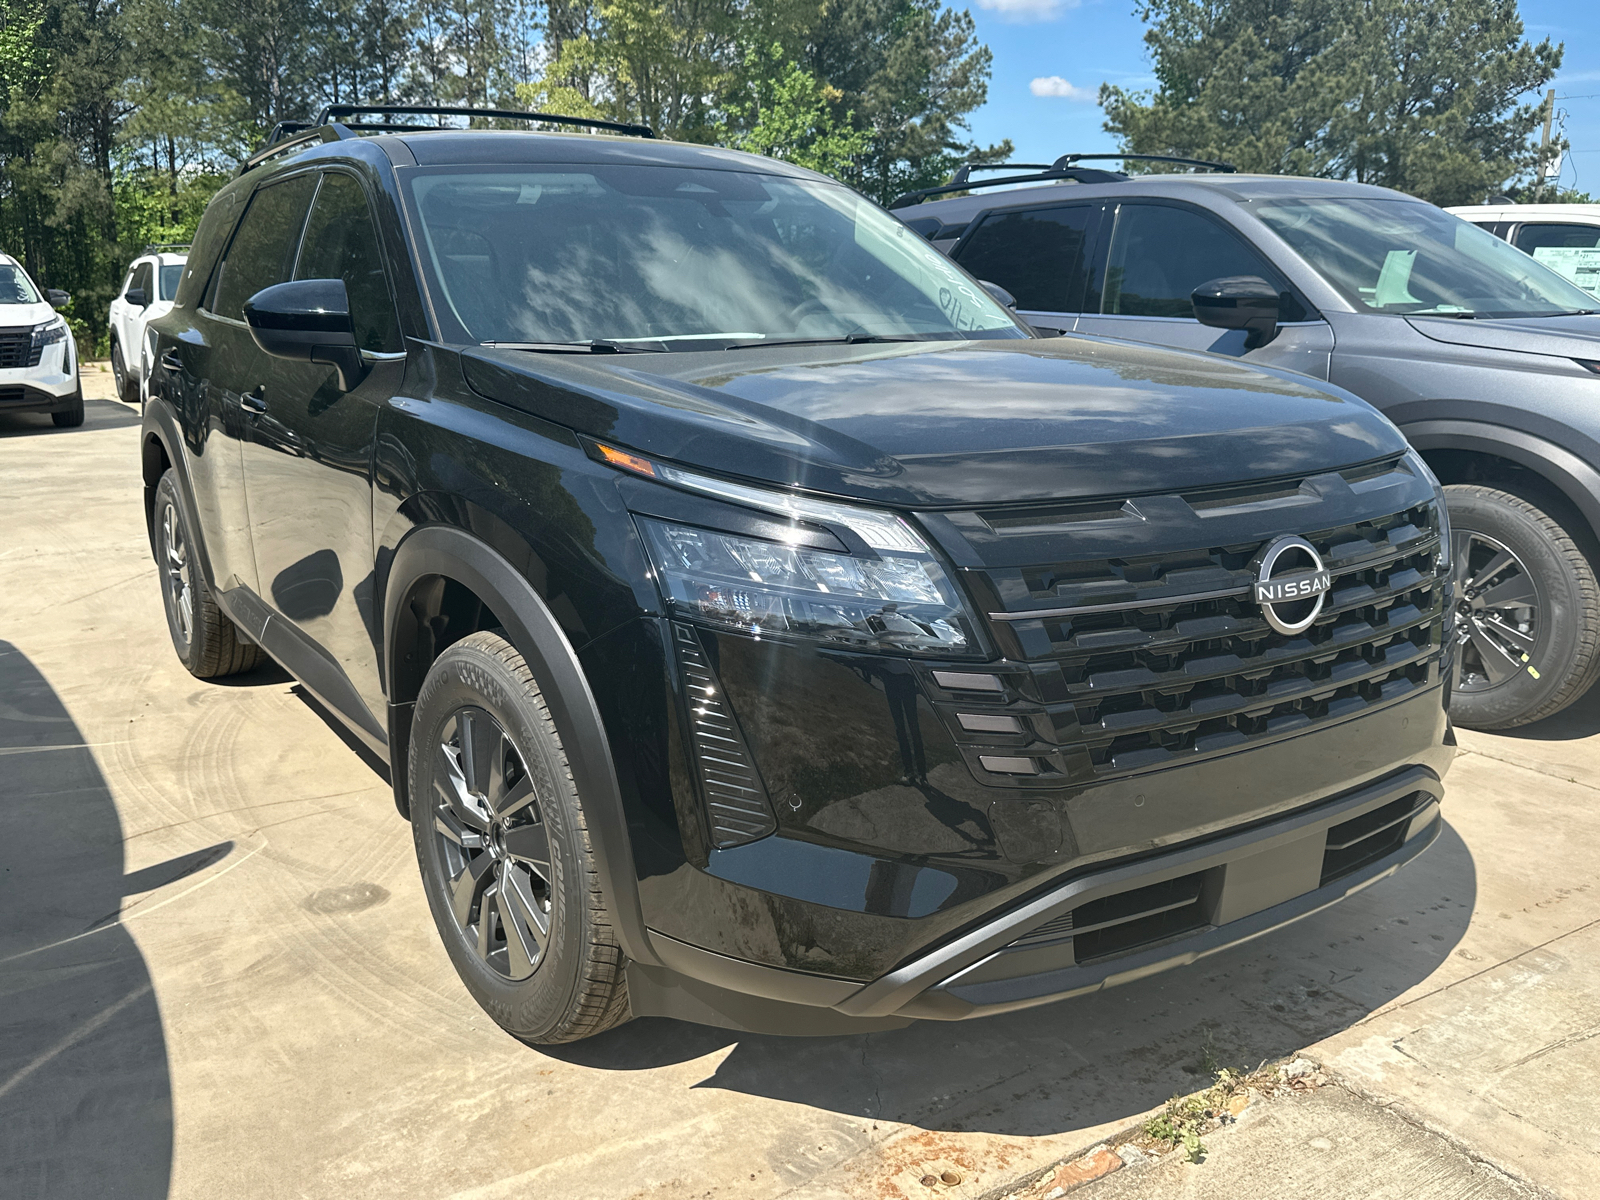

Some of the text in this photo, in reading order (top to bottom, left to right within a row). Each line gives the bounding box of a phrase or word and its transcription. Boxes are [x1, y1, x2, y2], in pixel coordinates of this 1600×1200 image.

[1258, 574, 1331, 601] NISSAN
[416, 670, 449, 722] KUMHO
[551, 838, 567, 958] CRUGEN
